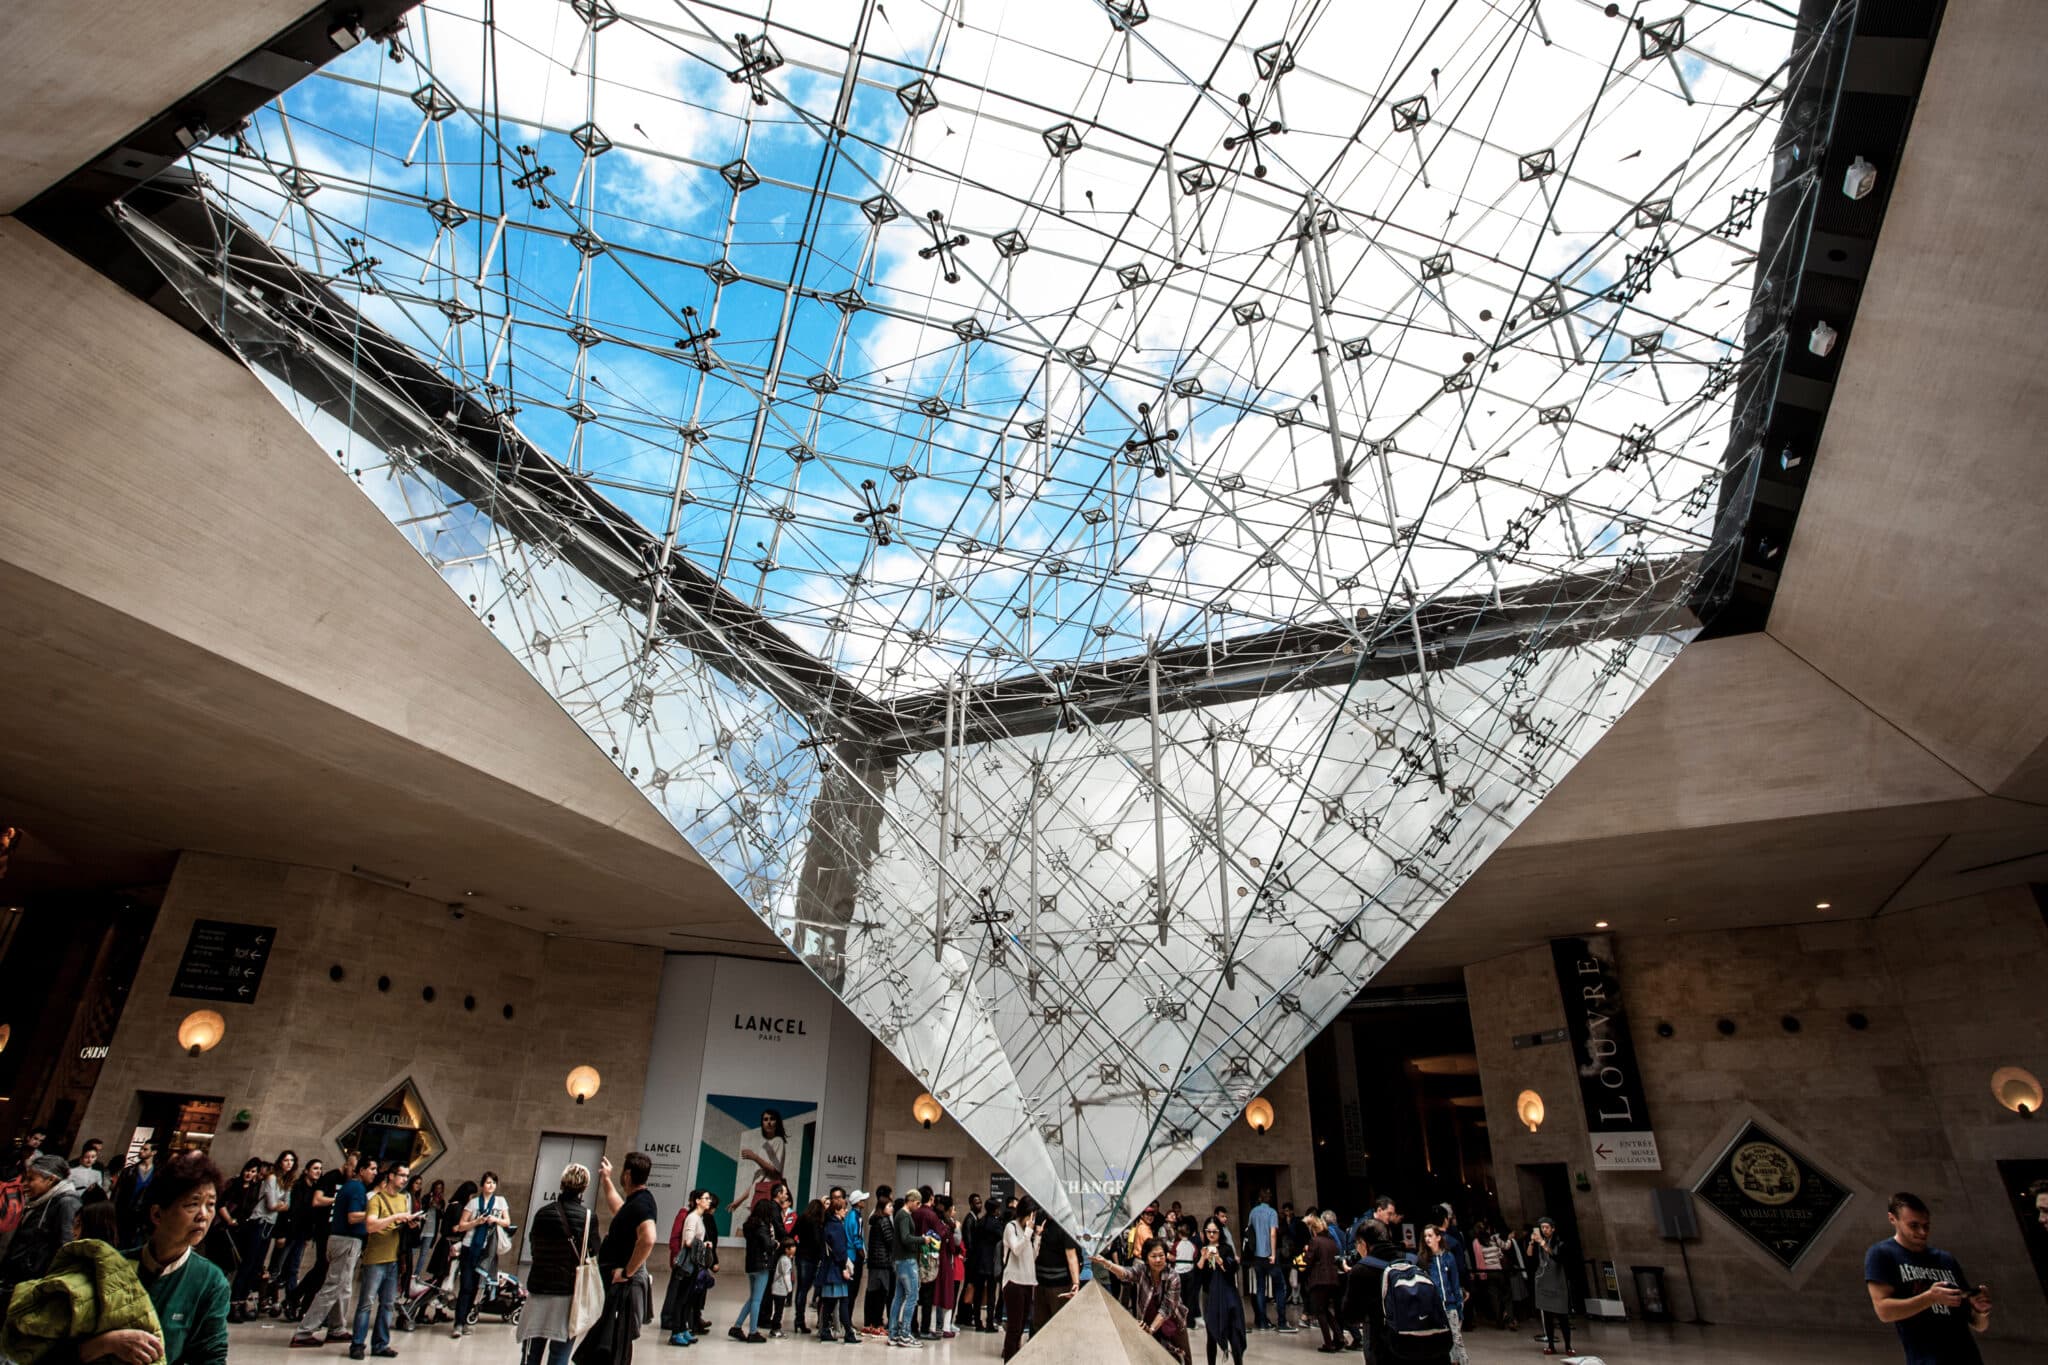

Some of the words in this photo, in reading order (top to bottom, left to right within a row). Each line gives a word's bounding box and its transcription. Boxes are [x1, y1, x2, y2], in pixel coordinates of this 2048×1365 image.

[734, 1014, 807, 1035] LANCEL
[758, 1034, 781, 1042] PARIS
[1577, 957, 1634, 1125] LOUVRE
[644, 1143, 681, 1154] LANCEL
[827, 1154, 857, 1166] LANCEL
[1061, 1180, 1125, 1195] HANGE
[1931, 1303, 1951, 1316] USA
